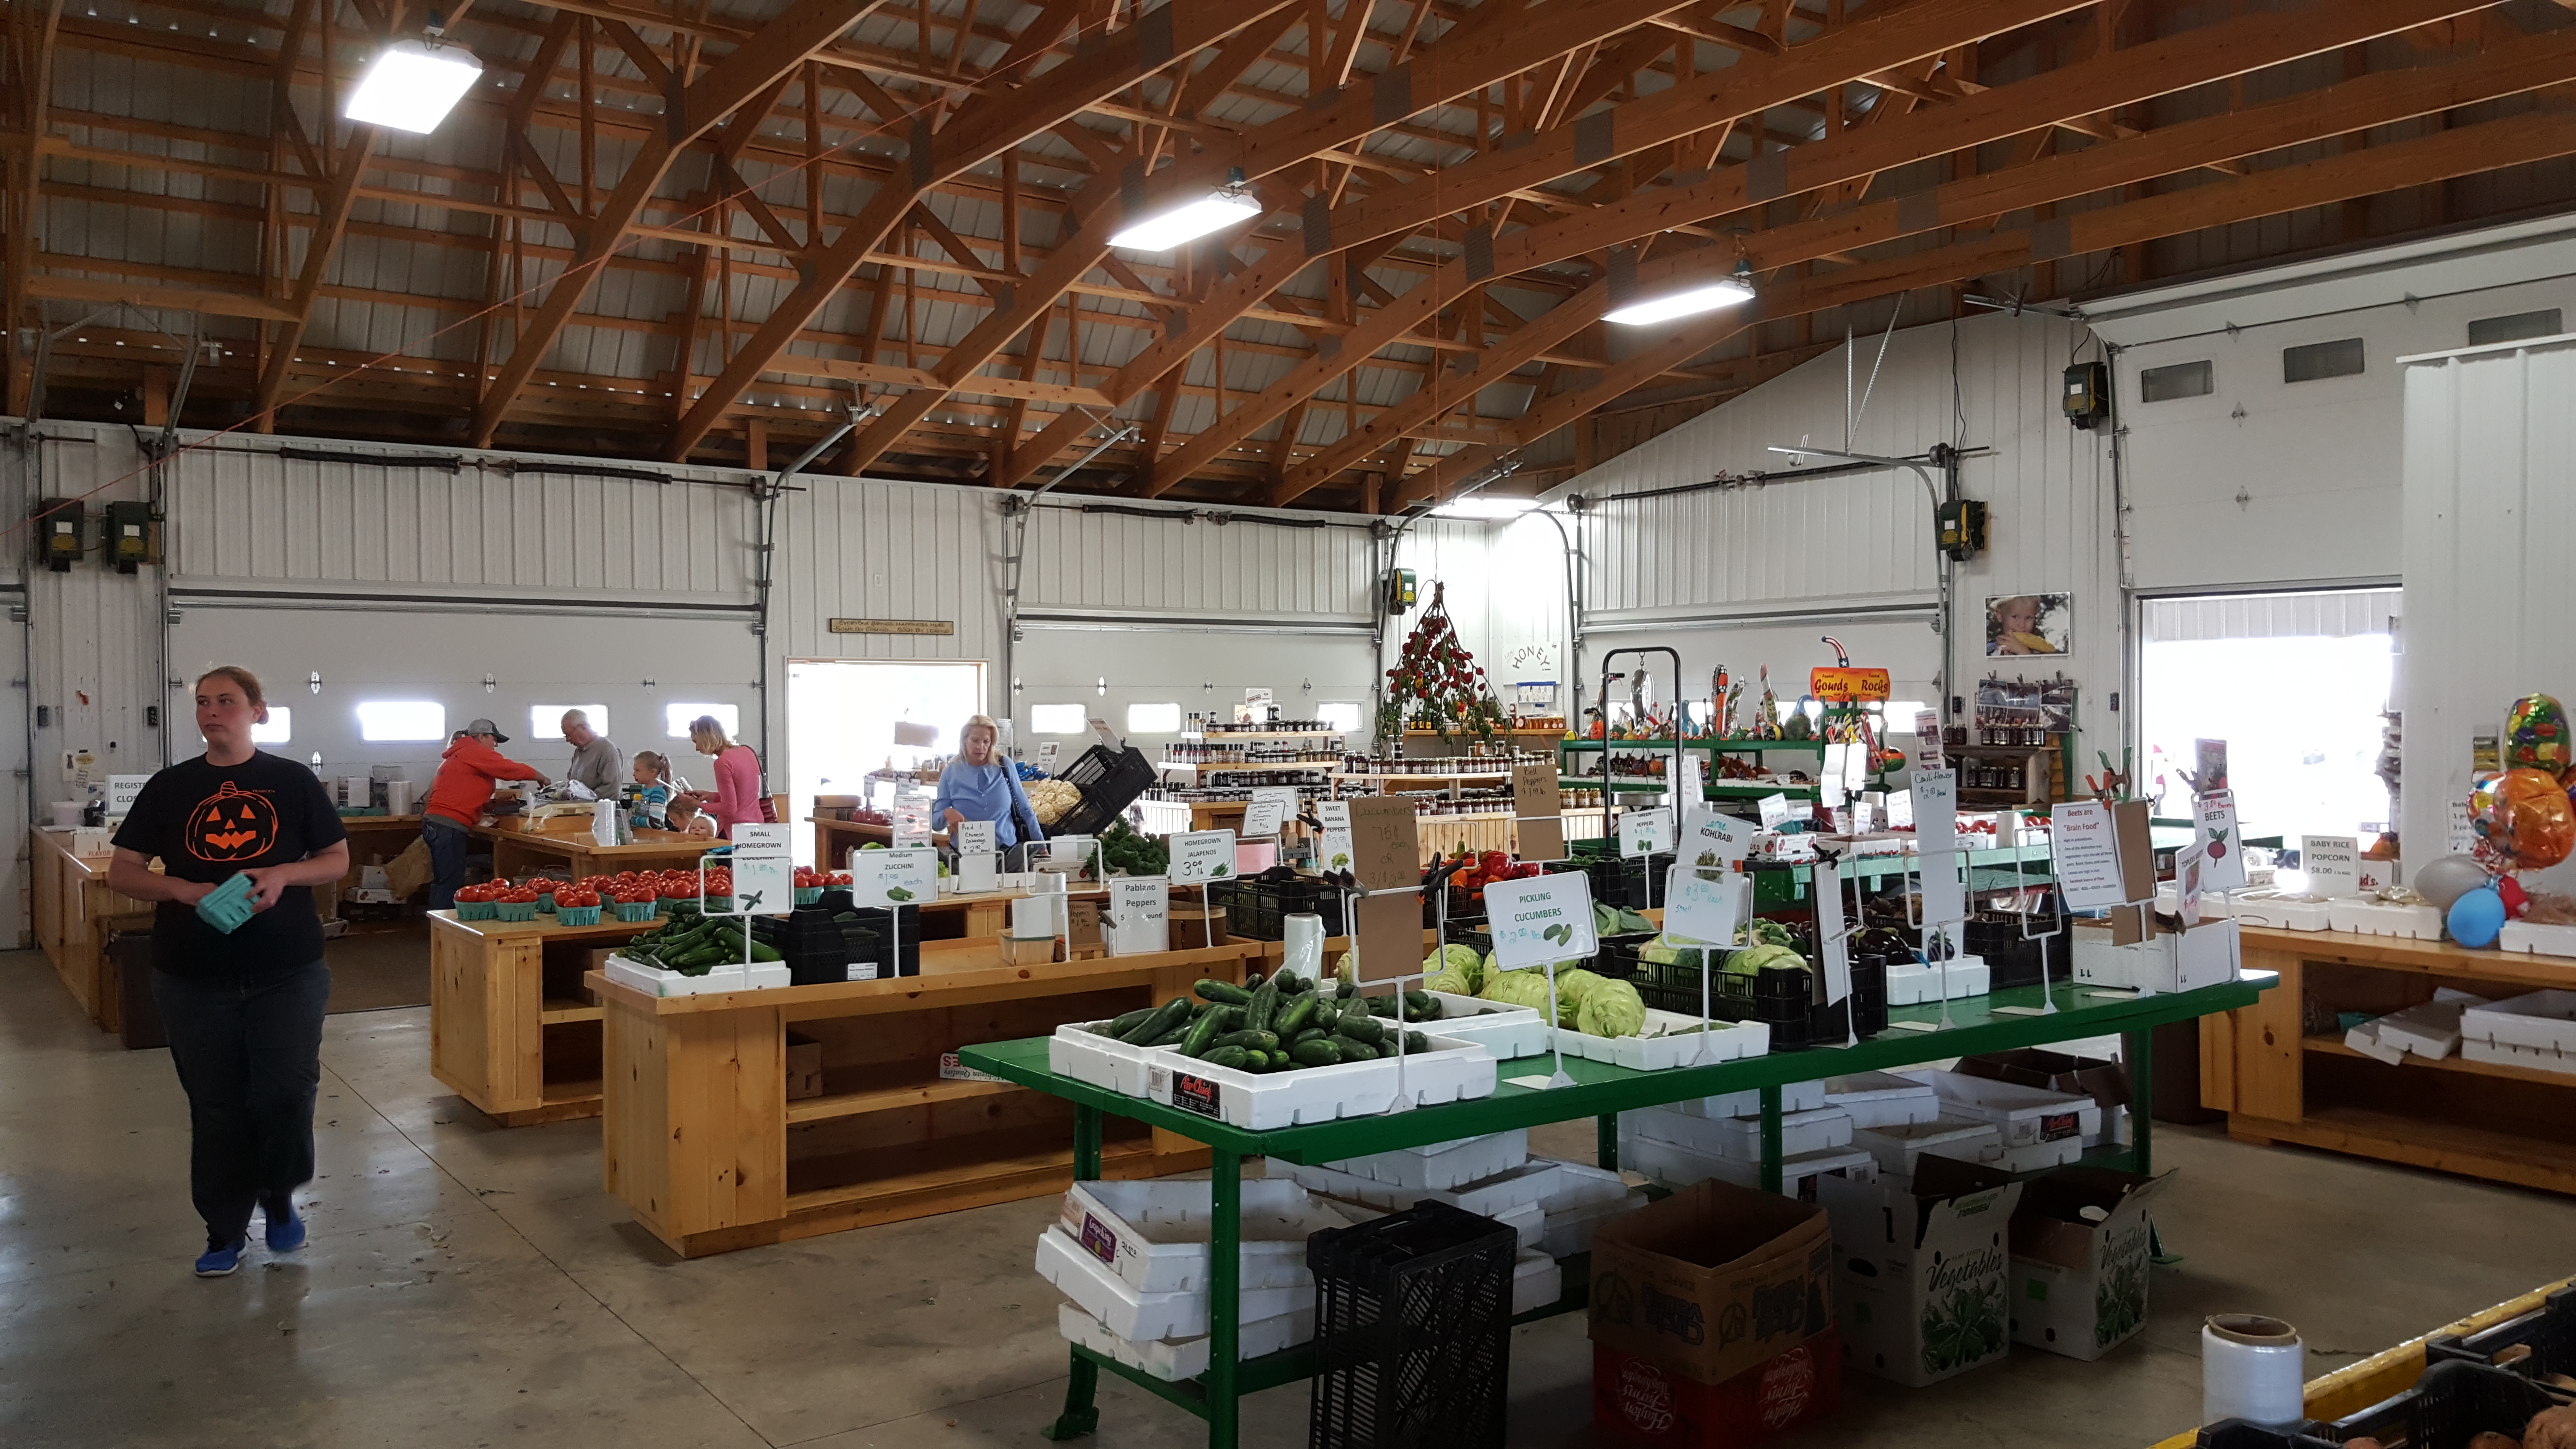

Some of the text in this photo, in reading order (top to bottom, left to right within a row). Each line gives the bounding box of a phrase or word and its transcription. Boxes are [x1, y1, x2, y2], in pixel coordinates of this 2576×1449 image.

[1513, 645, 1551, 671] HONEY!
[1815, 678, 1888, 693] Gourds Rocks
[1524, 767, 1537, 775] Bell
[1523, 776, 1546, 787] Peppers
[1355, 802, 1413, 817] Cucumbers
[2205, 811, 2225, 821] BEETS
[1706, 819, 1727, 830] Large
[1700, 827, 1733, 843] KOHLRABI
[1184, 837, 1221, 846] HOMEGROWN
[1188, 849, 1217, 857] JALAPENOS
[2312, 853, 2350, 862] POPCORN
[904, 877, 922, 886] each
[1519, 892, 1551, 903] PICKLING
[1126, 900, 1156, 908] Peppers
[1514, 907, 1562, 922] CUCUMBERS
[944, 1068, 970, 1078] Quality
[1180, 1076, 1193, 1091] Air
[1193, 1079, 1212, 1103] Chief
[2101, 1225, 2147, 1272] Vegetables
[1926, 1247, 2002, 1297] Vegetables
